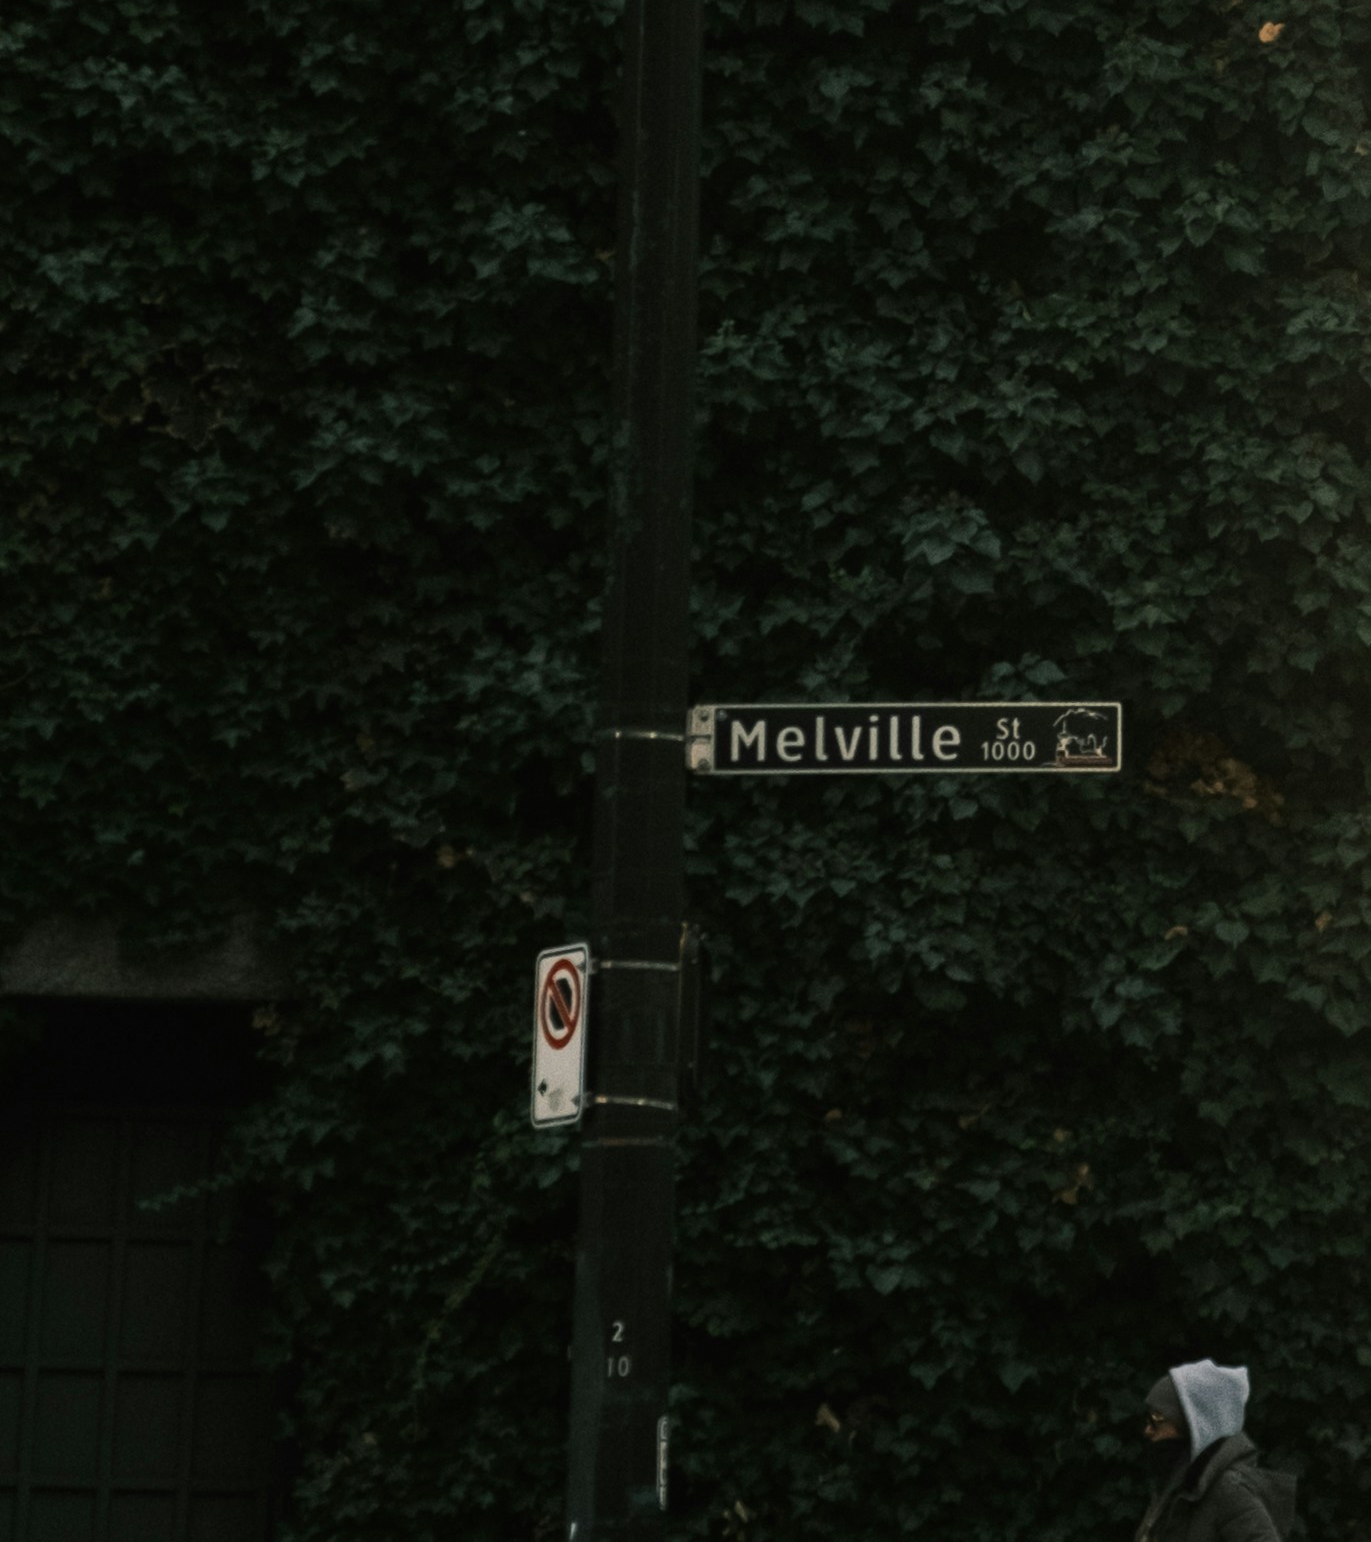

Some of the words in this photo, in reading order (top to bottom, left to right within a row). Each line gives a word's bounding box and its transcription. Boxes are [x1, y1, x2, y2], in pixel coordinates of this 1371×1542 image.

[731, 715, 961, 762] Melville
[996, 717, 1020, 740] St
[981, 741, 1036, 761] 1000
[612, 1321, 625, 1343] 2
[607, 1355, 631, 1378] 10
